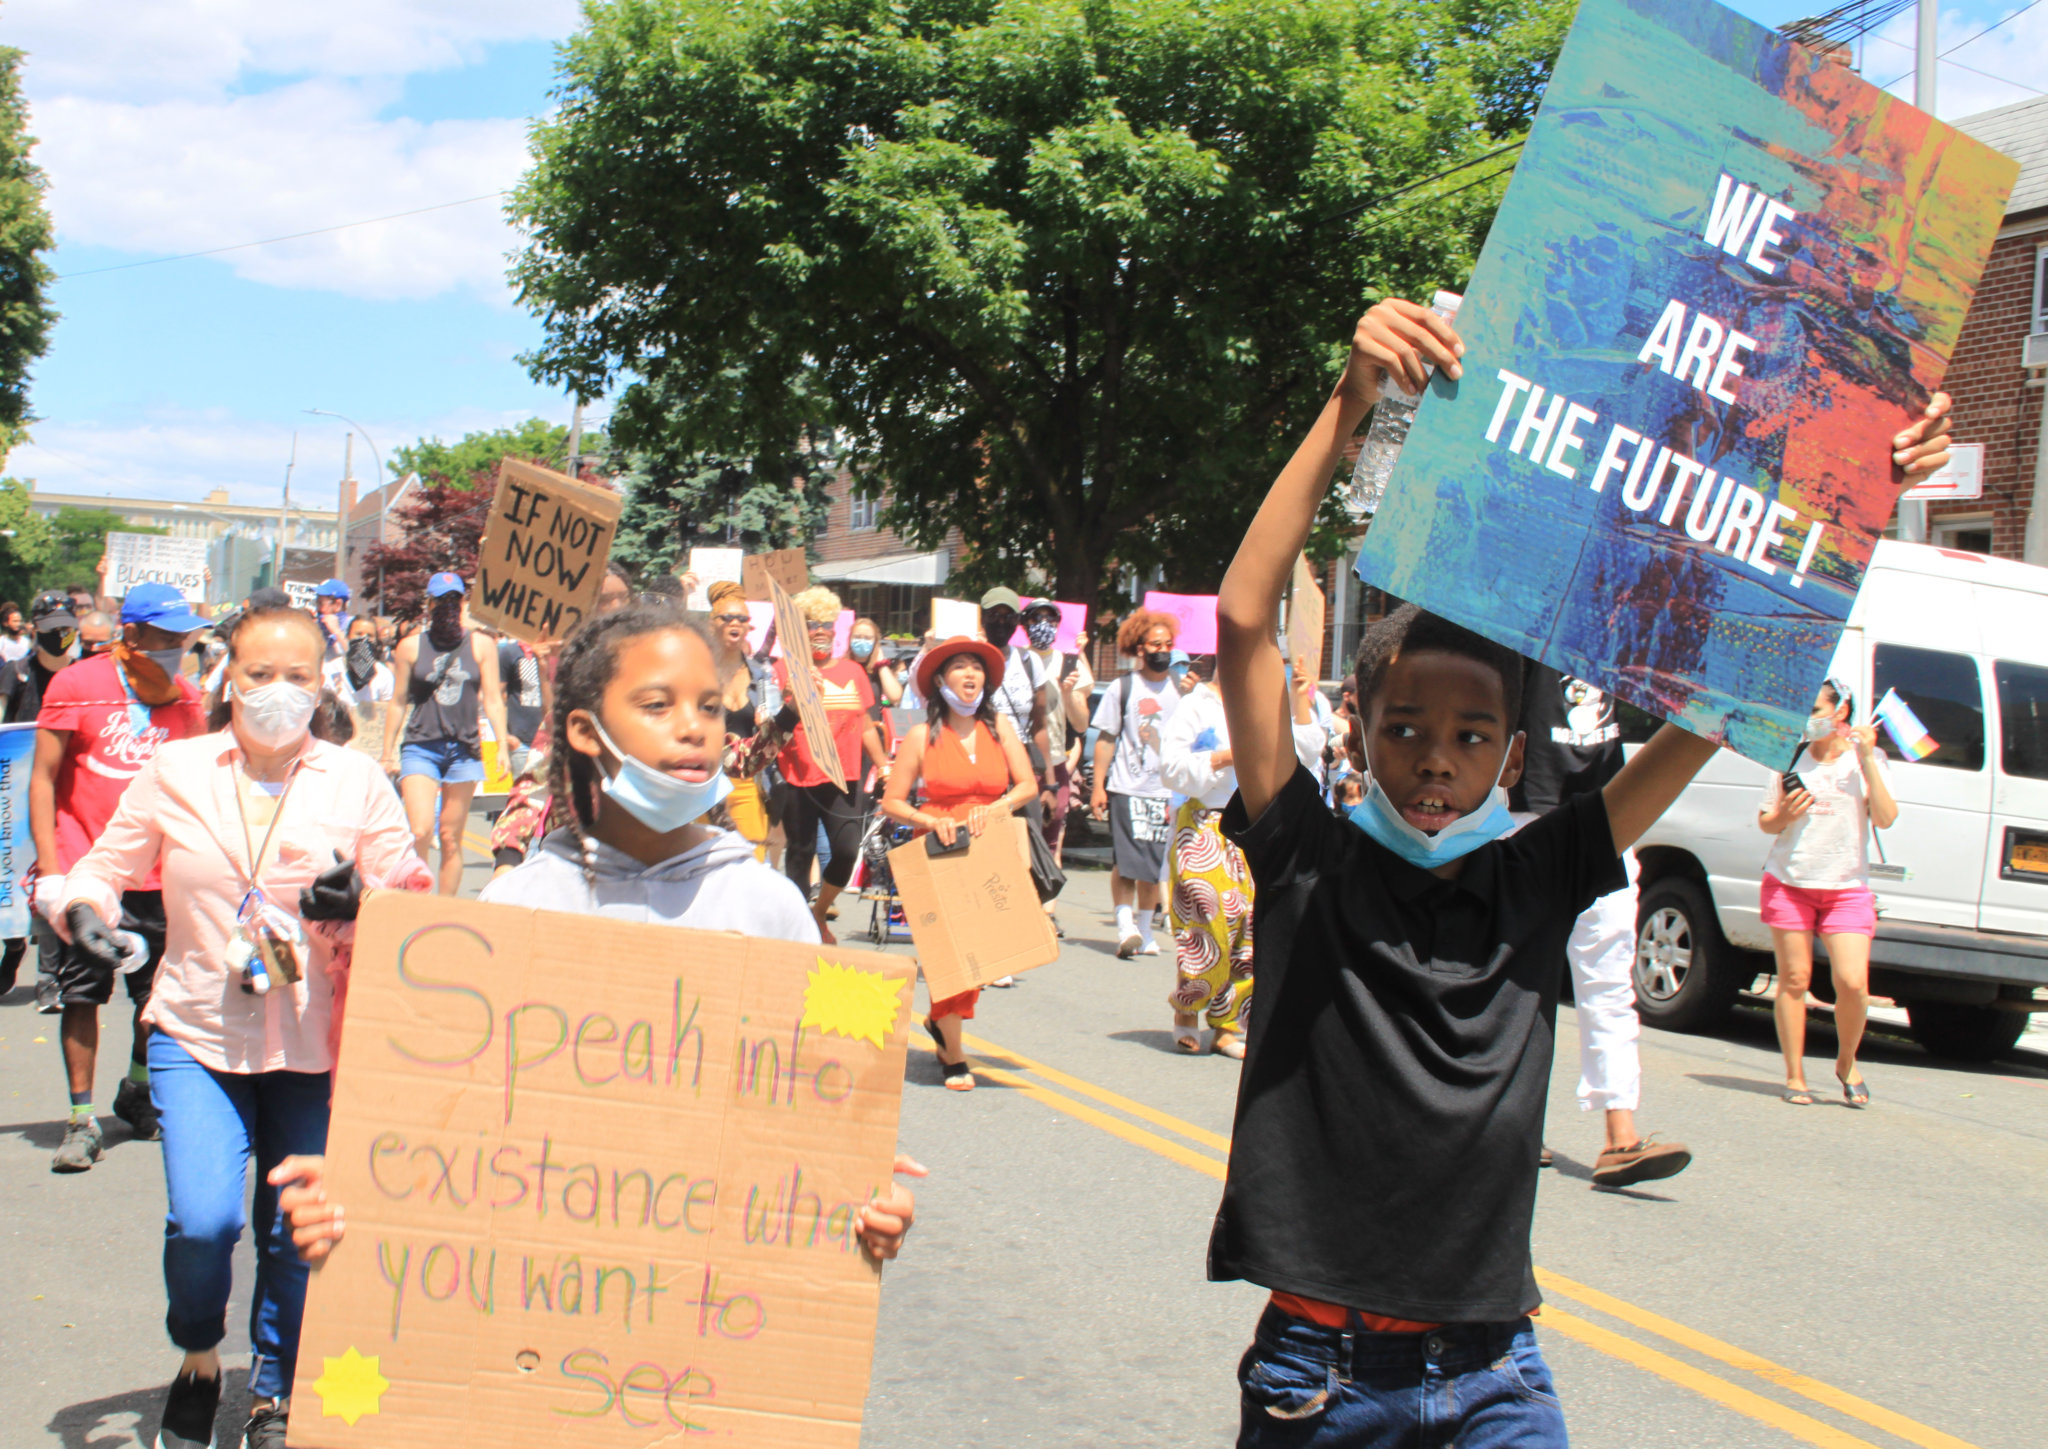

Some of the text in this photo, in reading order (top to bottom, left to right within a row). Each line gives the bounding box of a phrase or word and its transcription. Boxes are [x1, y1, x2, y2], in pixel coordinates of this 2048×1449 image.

[1703, 173, 1795, 275] WE
[1637, 298, 1757, 406] ARE
[1484, 367, 1598, 481] THE
[503, 484, 606, 557] IF NOT
[505, 529, 590, 592] NOW
[117, 563, 164, 585] BLACK
[482, 568, 582, 639] WHEN?
[0, 757, 15, 908] Did you know that
[388, 921, 854, 1126] Speak into
[368, 1130, 718, 1235] existance
[376, 1240, 767, 1342] you want to
